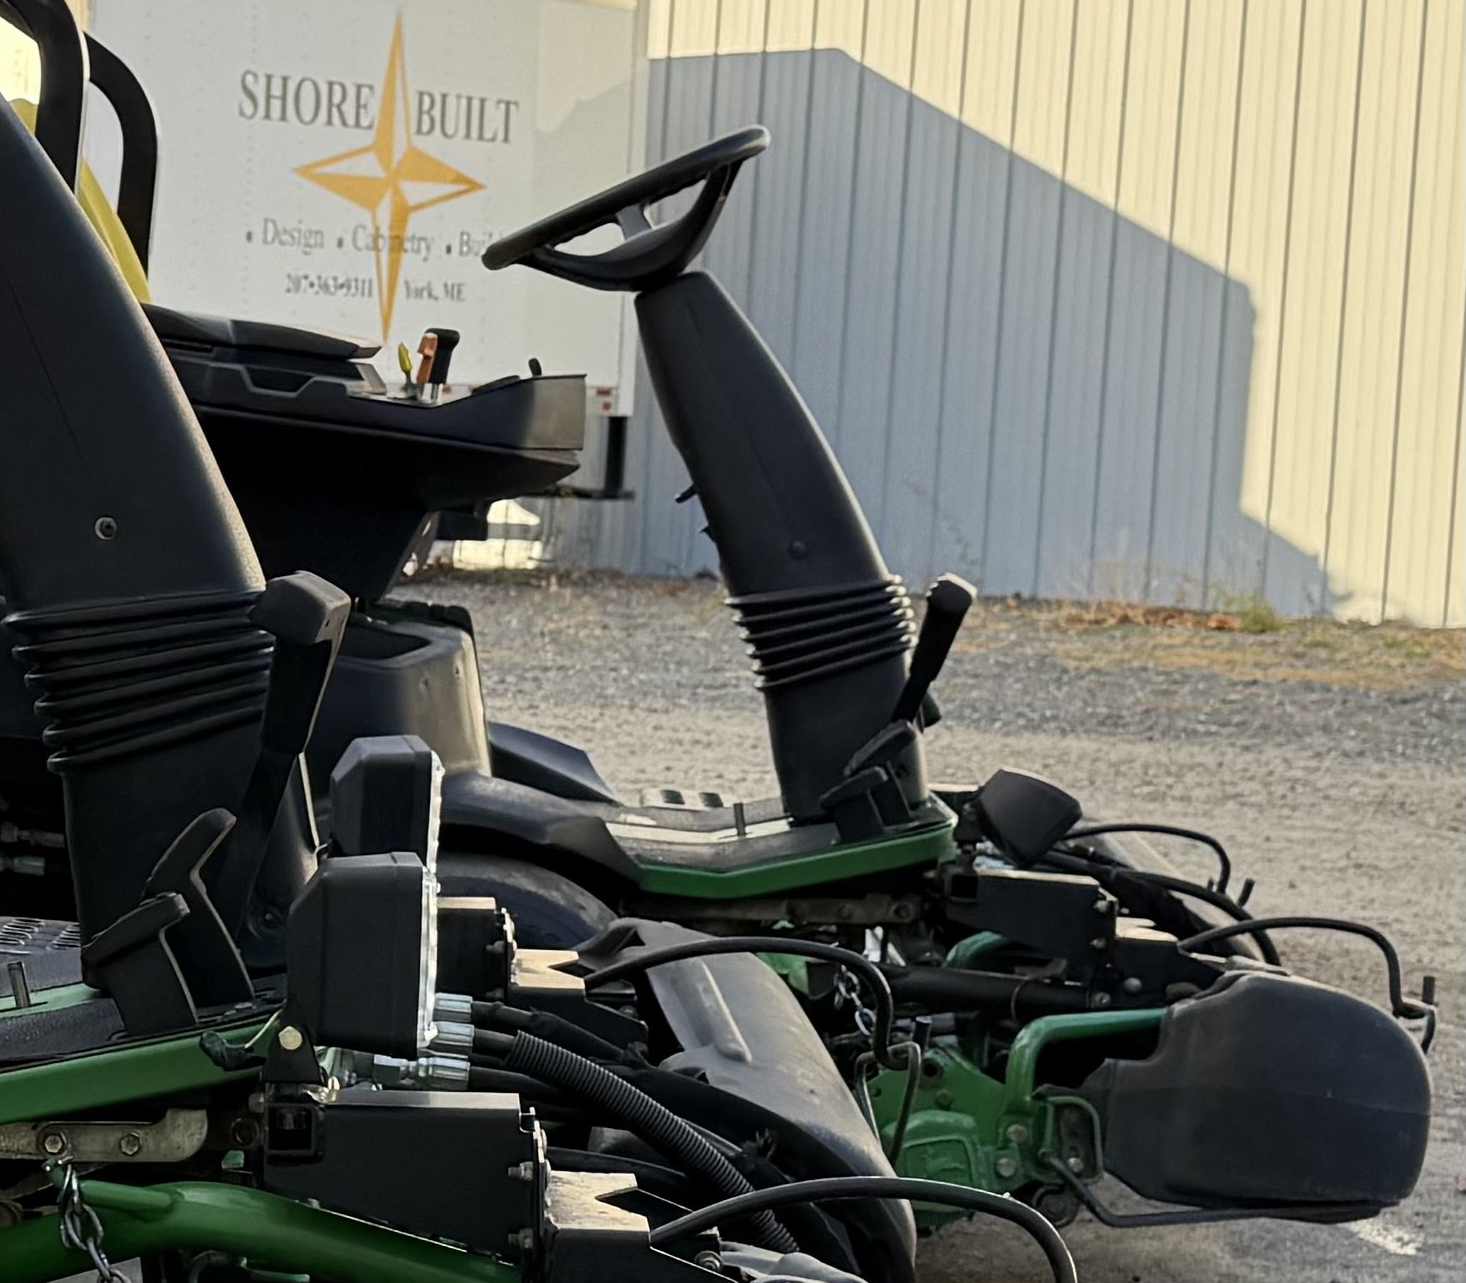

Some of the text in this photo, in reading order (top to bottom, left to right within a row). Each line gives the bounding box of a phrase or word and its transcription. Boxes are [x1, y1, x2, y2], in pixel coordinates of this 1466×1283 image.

[238, 69, 520, 144] SHORE BUILT
[262, 217, 325, 256] Design
